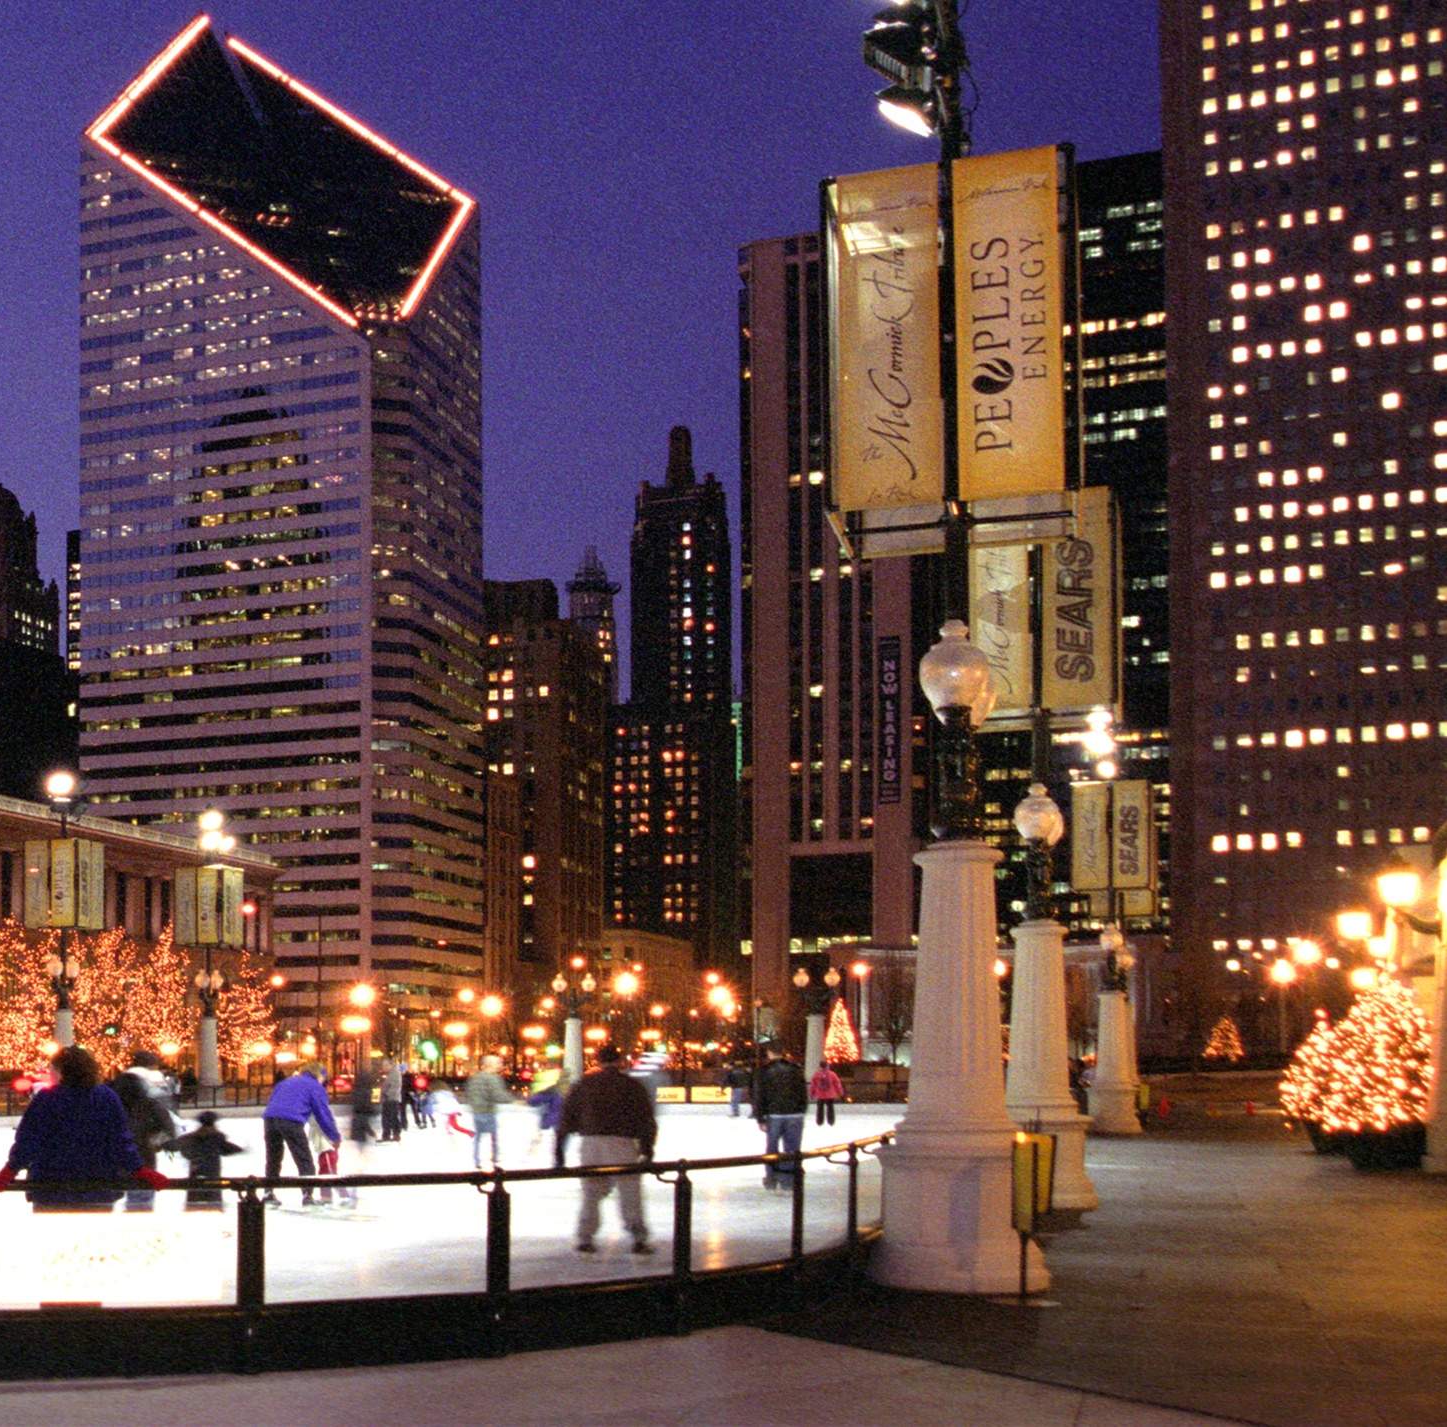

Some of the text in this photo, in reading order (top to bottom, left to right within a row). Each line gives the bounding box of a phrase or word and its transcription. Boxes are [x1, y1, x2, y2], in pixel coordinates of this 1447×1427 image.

[867, 300, 916, 480] McCormick
[970, 236, 1014, 455] PEOPLES
[1055, 538, 1096, 683] SEARS
[881, 659, 898, 782] NOW LEASING
[1119, 805, 1140, 876] SEARS
